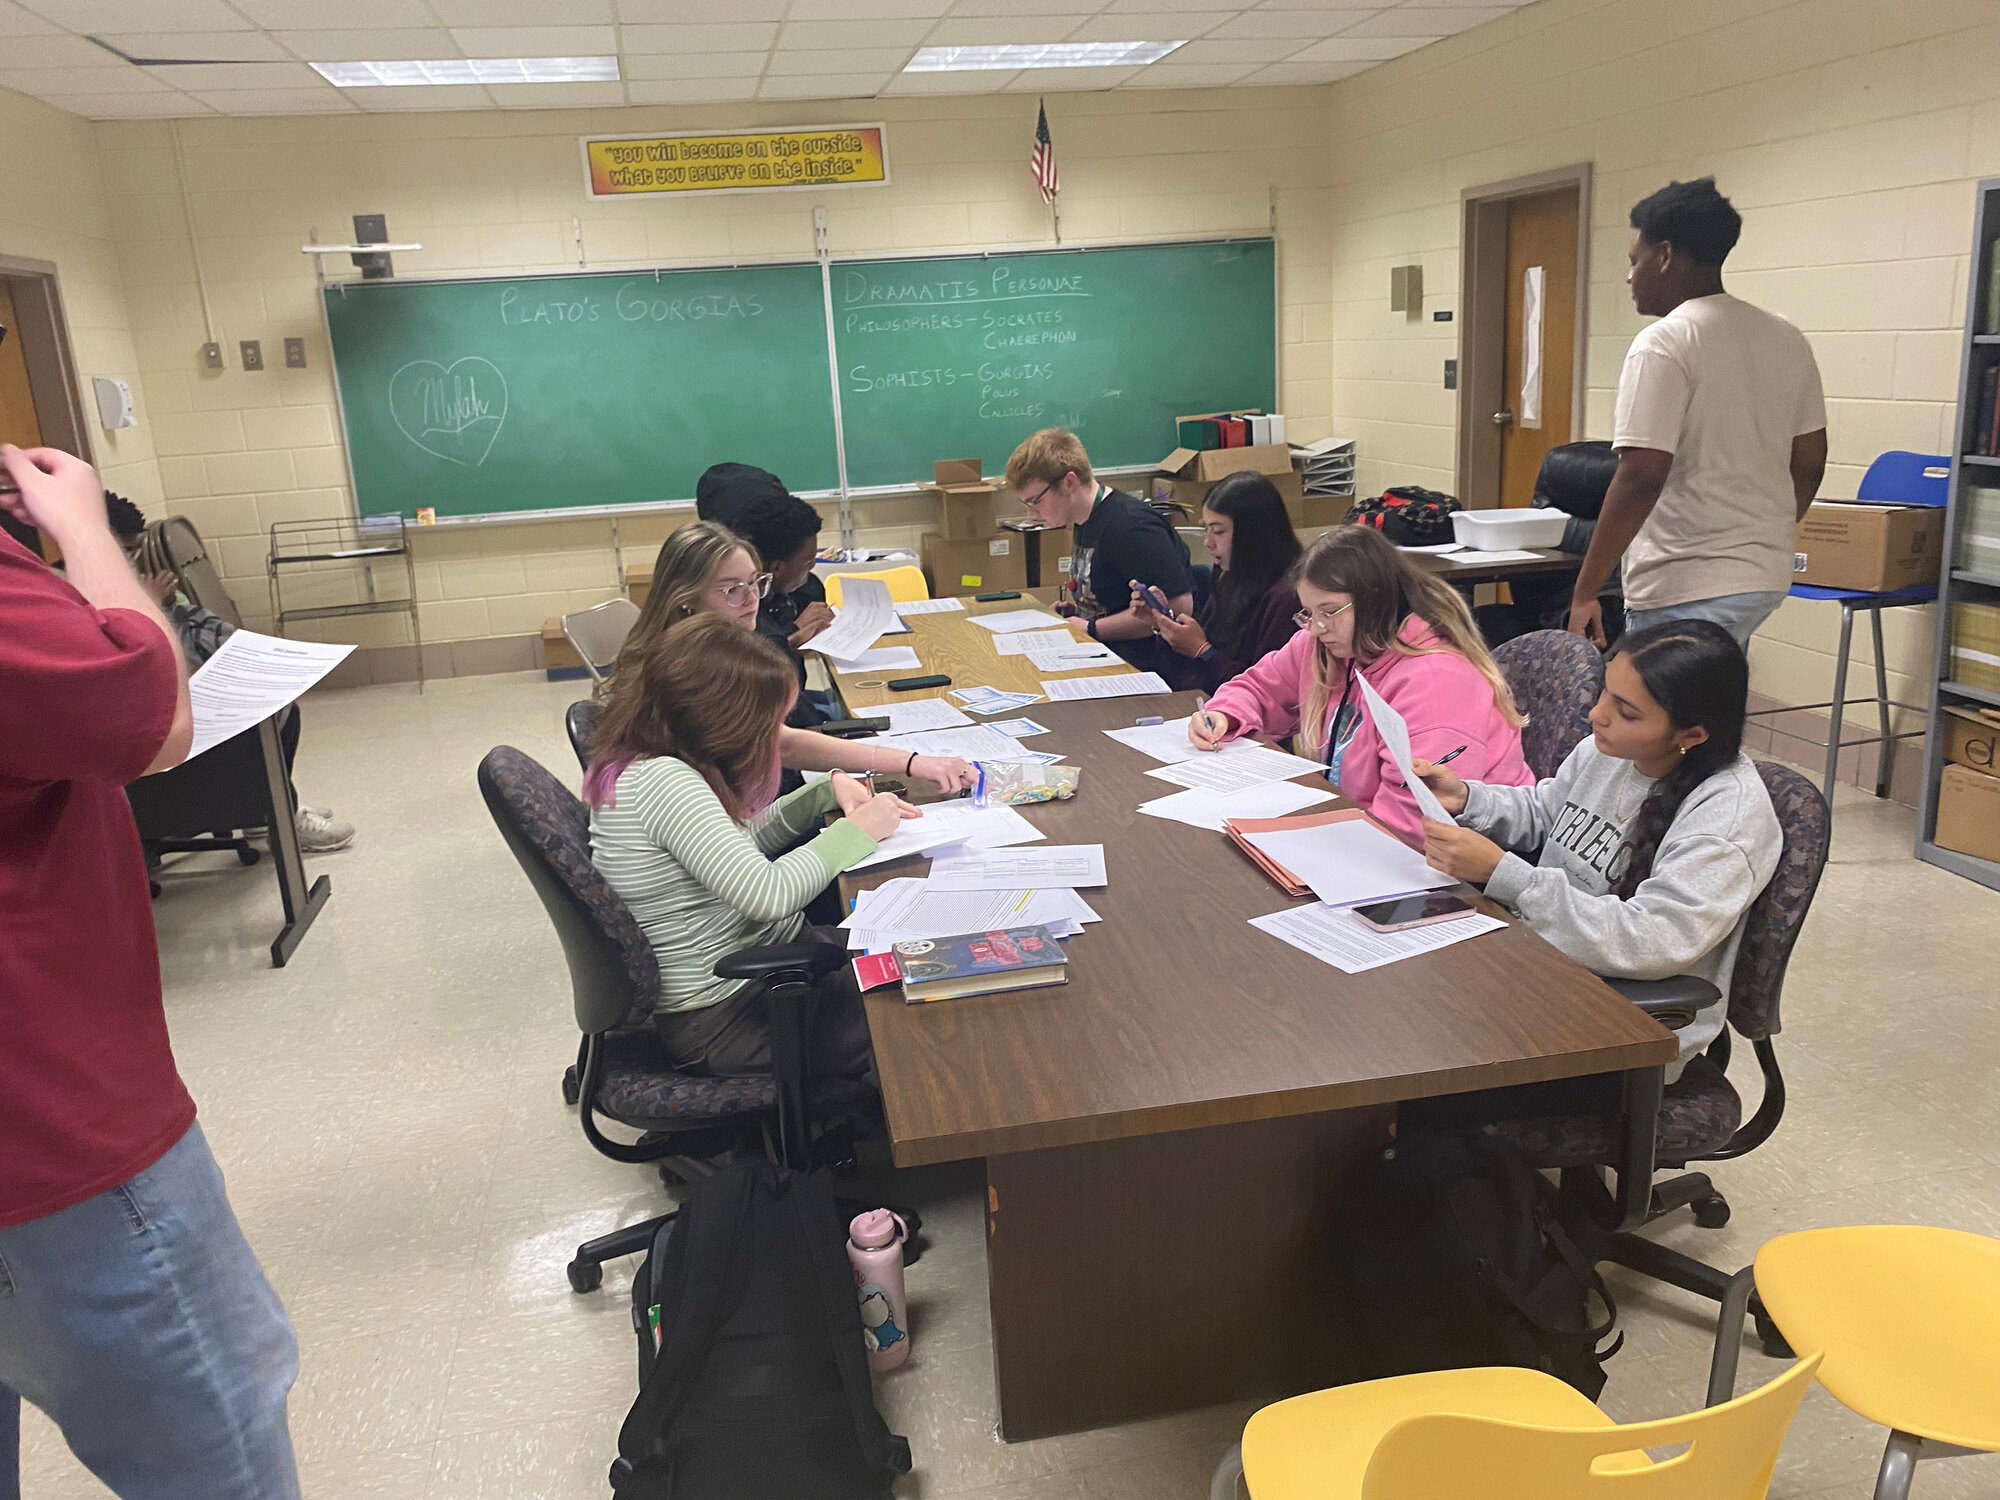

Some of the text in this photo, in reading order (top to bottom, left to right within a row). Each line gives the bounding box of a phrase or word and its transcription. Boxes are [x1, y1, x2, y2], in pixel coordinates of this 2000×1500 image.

[646, 142, 677, 162] will
[681, 142, 743, 160] become
[746, 140, 768, 158] on
[771, 137, 800, 157] the
[609, 166, 654, 186] what
[656, 166, 686, 185] you
[749, 163, 771, 180] on
[773, 159, 802, 179] the
[845, 266, 1084, 303] DRAMATIS PERSONAE
[982, 309, 1063, 329] SOCRATES
[1550, 800, 1636, 886] TRIBEC
